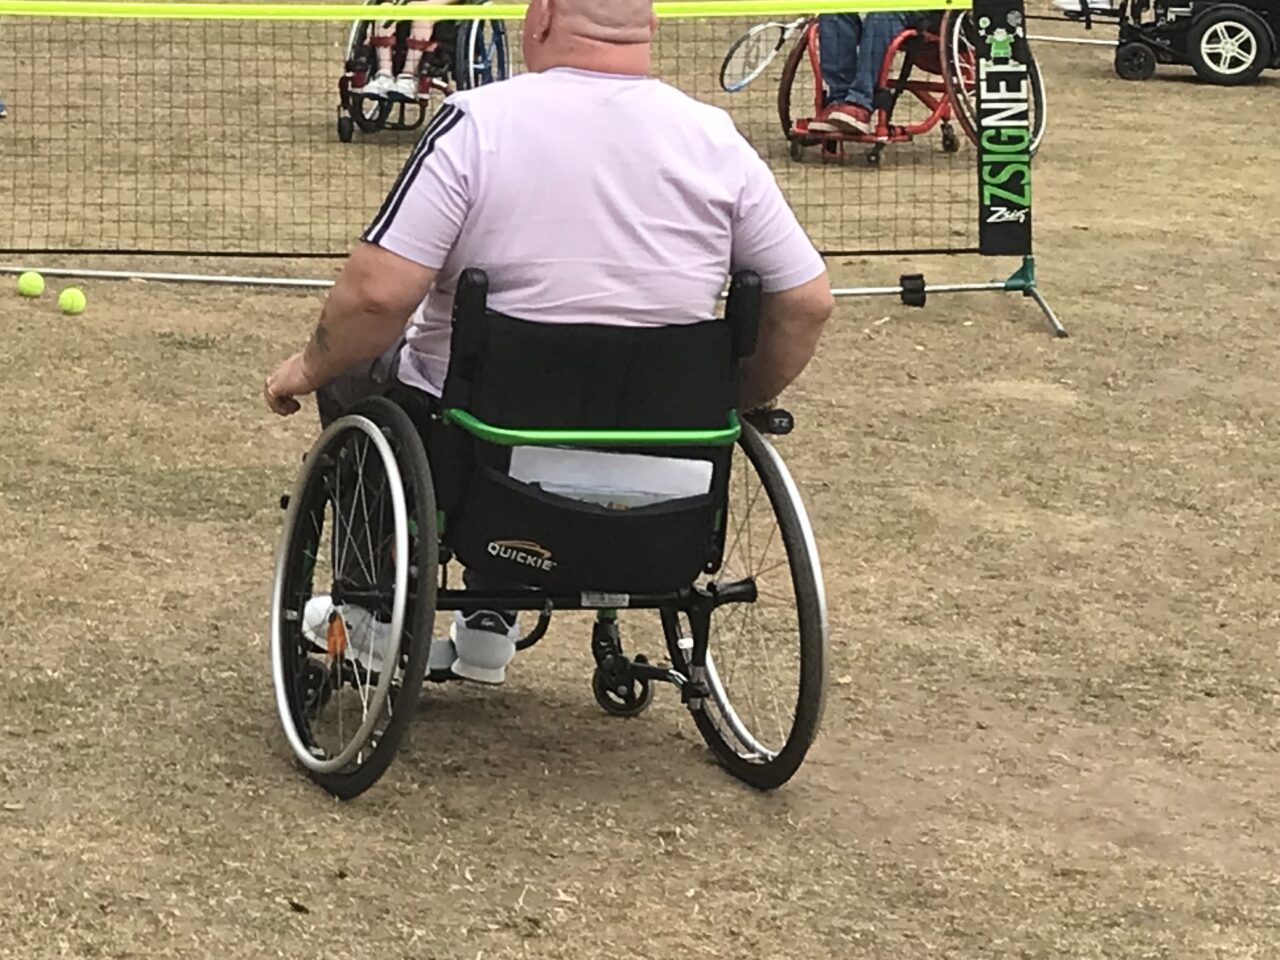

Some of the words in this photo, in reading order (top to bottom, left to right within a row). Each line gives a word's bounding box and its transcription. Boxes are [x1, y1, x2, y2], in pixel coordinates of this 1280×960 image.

[980, 58, 1031, 207] ZSIGNET
[986, 206, 1029, 224] Zsig
[487, 541, 553, 572] QUICKIE
